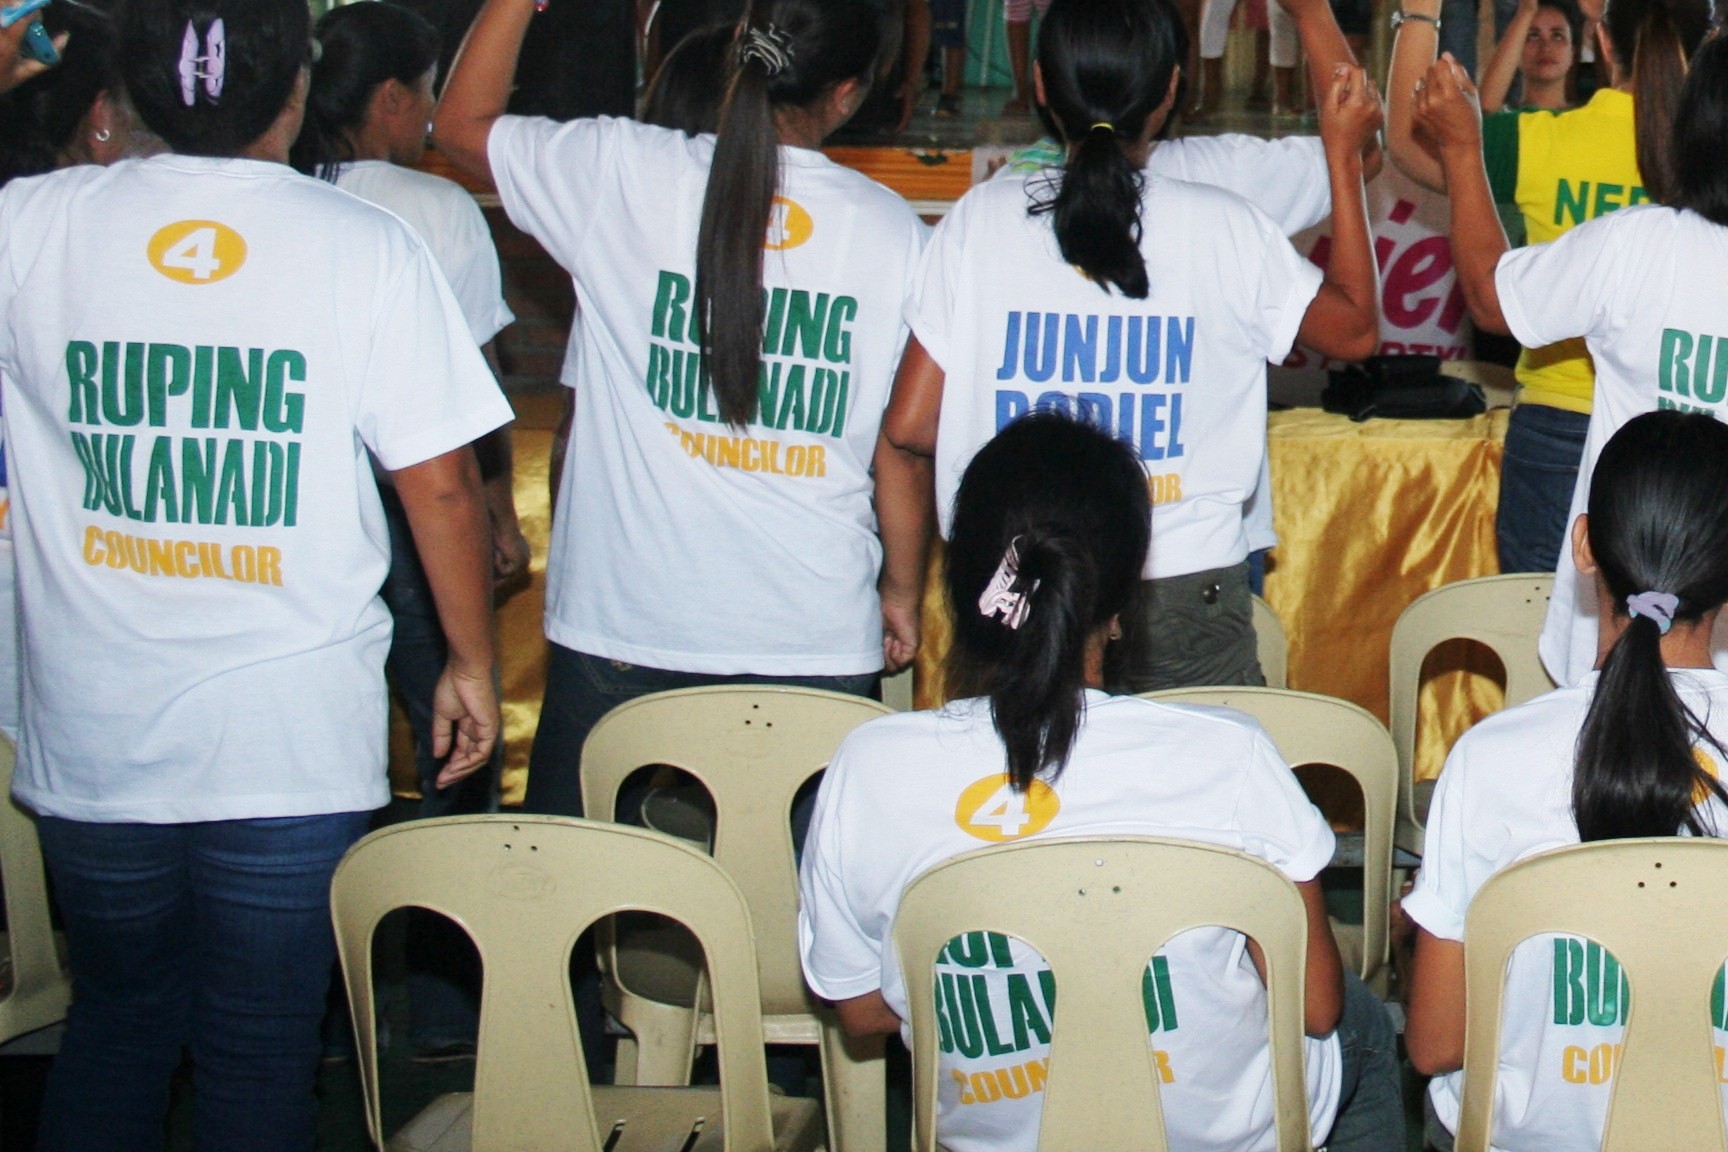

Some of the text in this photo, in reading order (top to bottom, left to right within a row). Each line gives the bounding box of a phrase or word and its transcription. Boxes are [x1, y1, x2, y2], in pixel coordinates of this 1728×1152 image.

[161, 227, 221, 280] 4
[996, 311, 1195, 385] JUNJUN
[66, 340, 307, 434] RUPING
[83, 525, 285, 587] COUNCILOR
[968, 780, 1031, 836] 4
